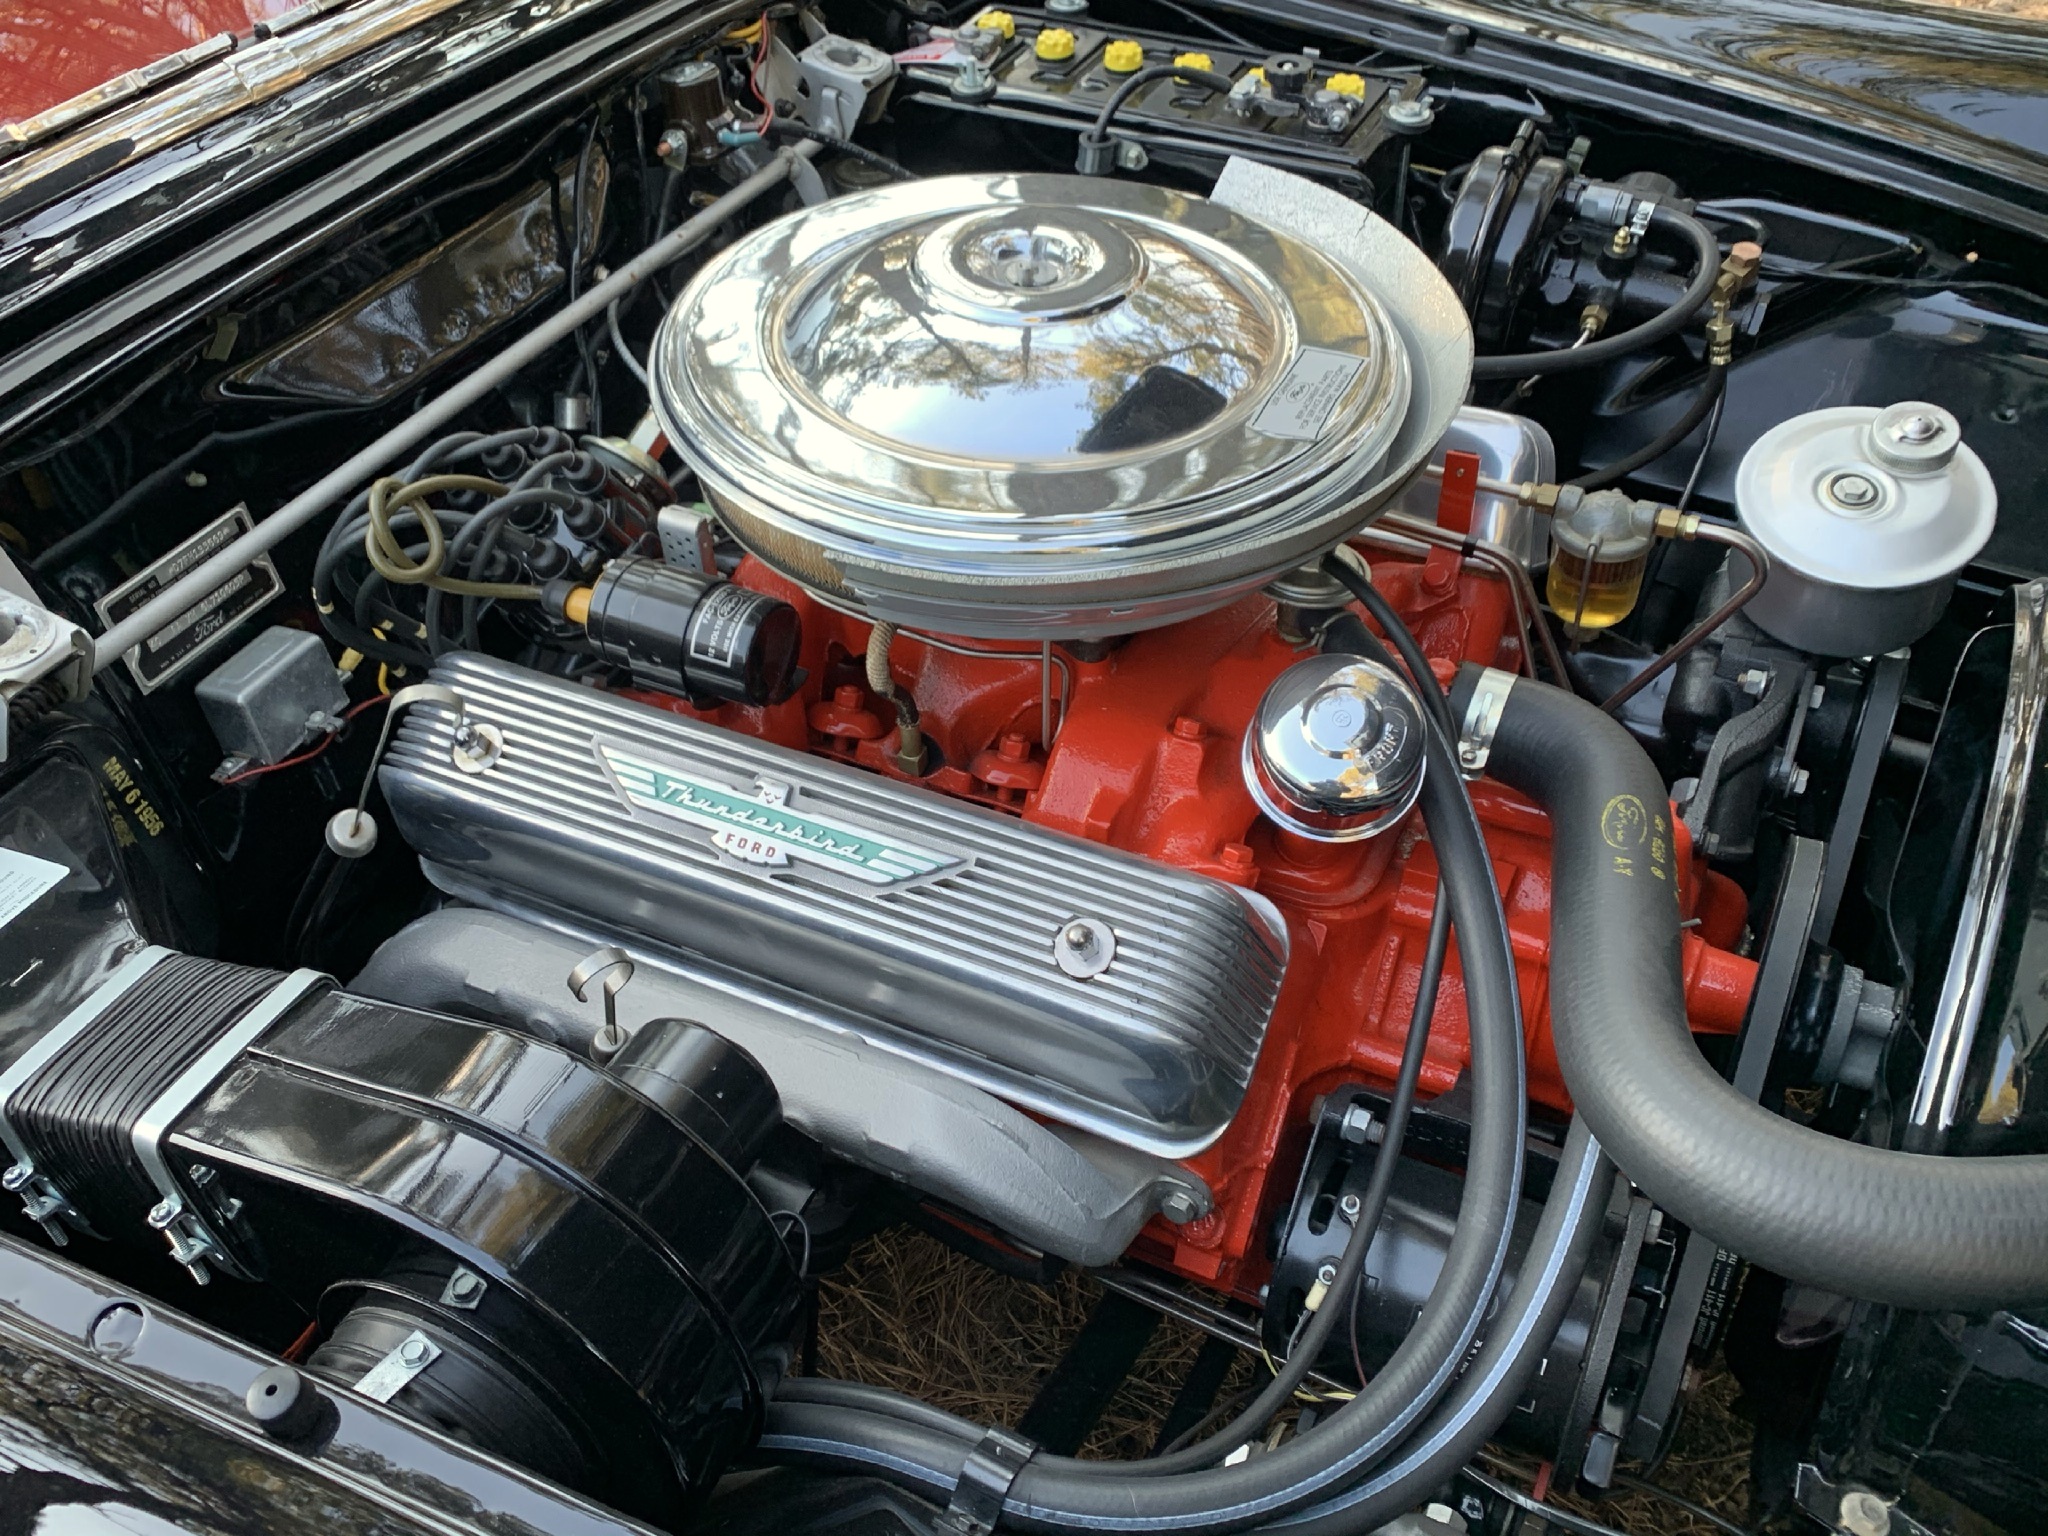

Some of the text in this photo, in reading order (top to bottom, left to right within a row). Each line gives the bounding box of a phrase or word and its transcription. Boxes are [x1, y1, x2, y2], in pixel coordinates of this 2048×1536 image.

[193, 610, 225, 643] Ford
[709, 619, 724, 646] VOLTS
[723, 638, 731, 652] USE
[727, 622, 736, 638] WITH
[1365, 722, 1400, 767] FRONT
[102, 756, 134, 792] MAY
[125, 788, 141, 805] 6
[134, 799, 165, 837] 1956
[660, 779, 868, 863] Thunderbird
[725, 833, 777, 859] FORD
